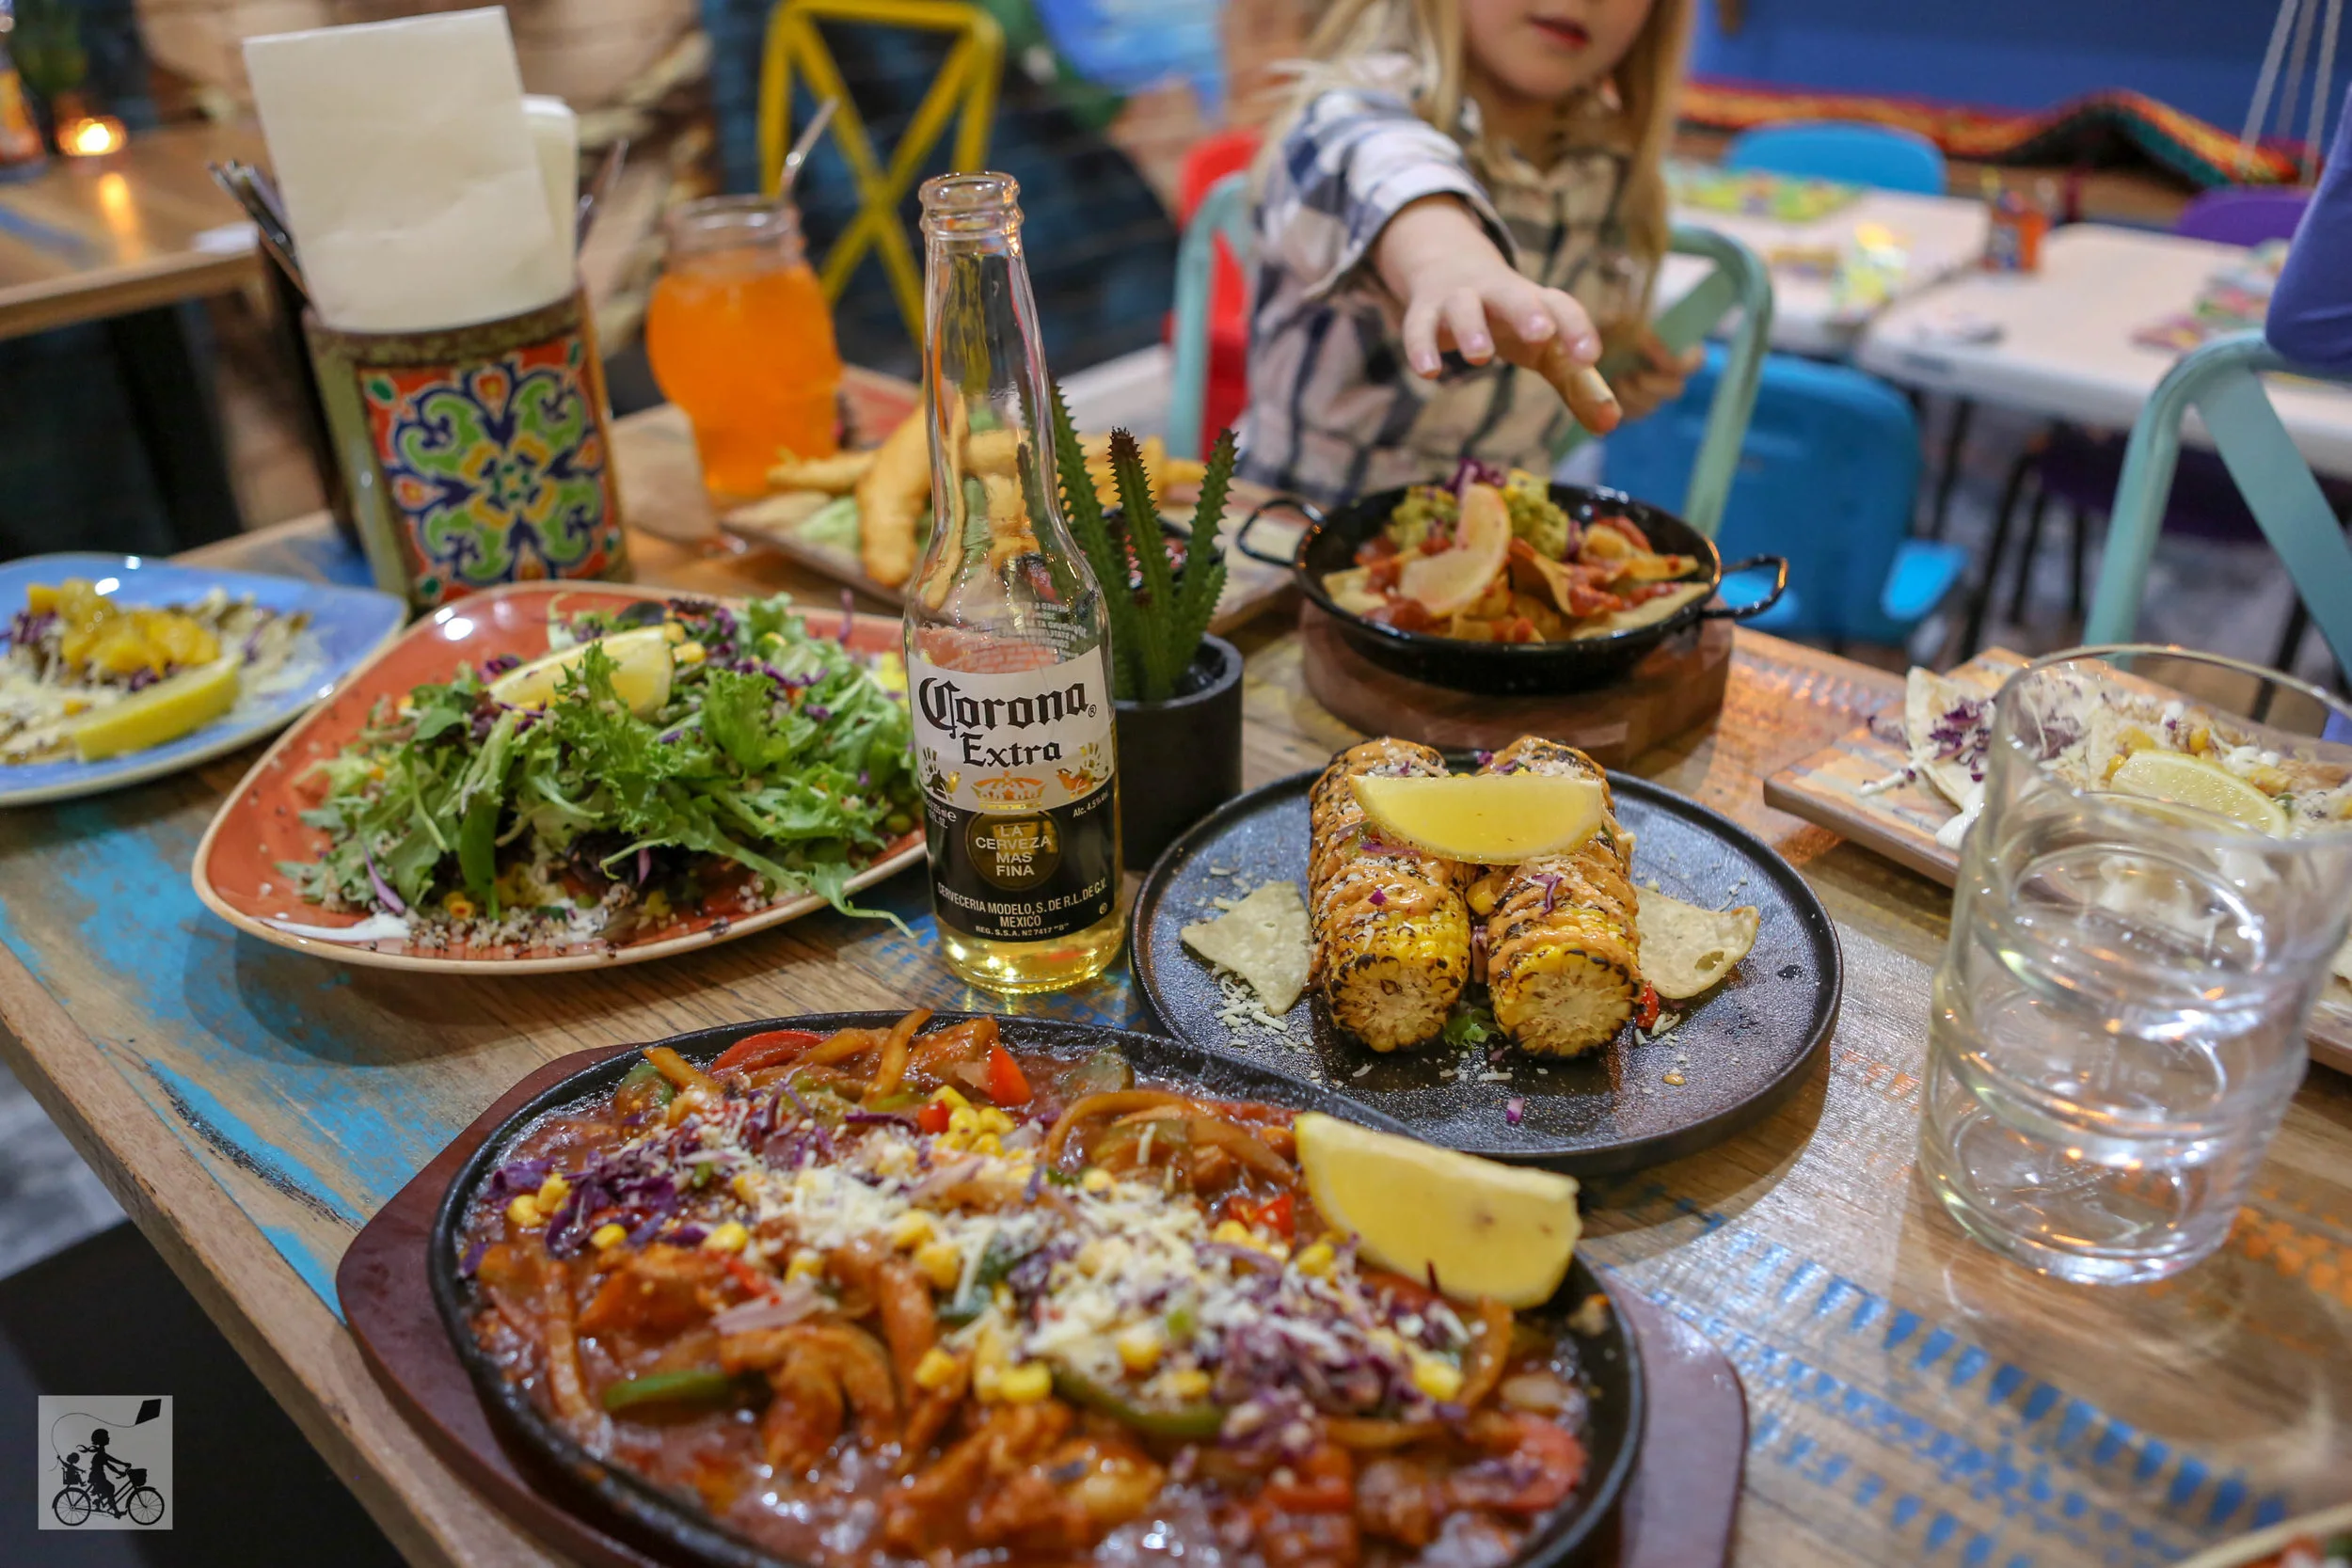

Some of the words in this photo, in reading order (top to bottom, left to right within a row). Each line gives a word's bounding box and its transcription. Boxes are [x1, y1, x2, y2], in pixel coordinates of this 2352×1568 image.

[960, 732, 1062, 768] Extra
[1000, 825, 1023, 837] LA
[976, 835, 1052, 849] CERVEZA
[996, 852, 1033, 863] MAS
[996, 865, 1035, 877] FINA
[938, 881, 986, 912] CERVECERIA
[987, 902, 1035, 915] MODELO,
[1036, 902, 1047, 912] S.
[1048, 898, 1062, 911] DE
[1063, 894, 1082, 908] R.L.
[1082, 885, 1094, 900] DE
[999, 915, 1041, 928] MEXICO
[976, 926, 993, 935] REG.
[1034, 927, 1052, 936] 7417
